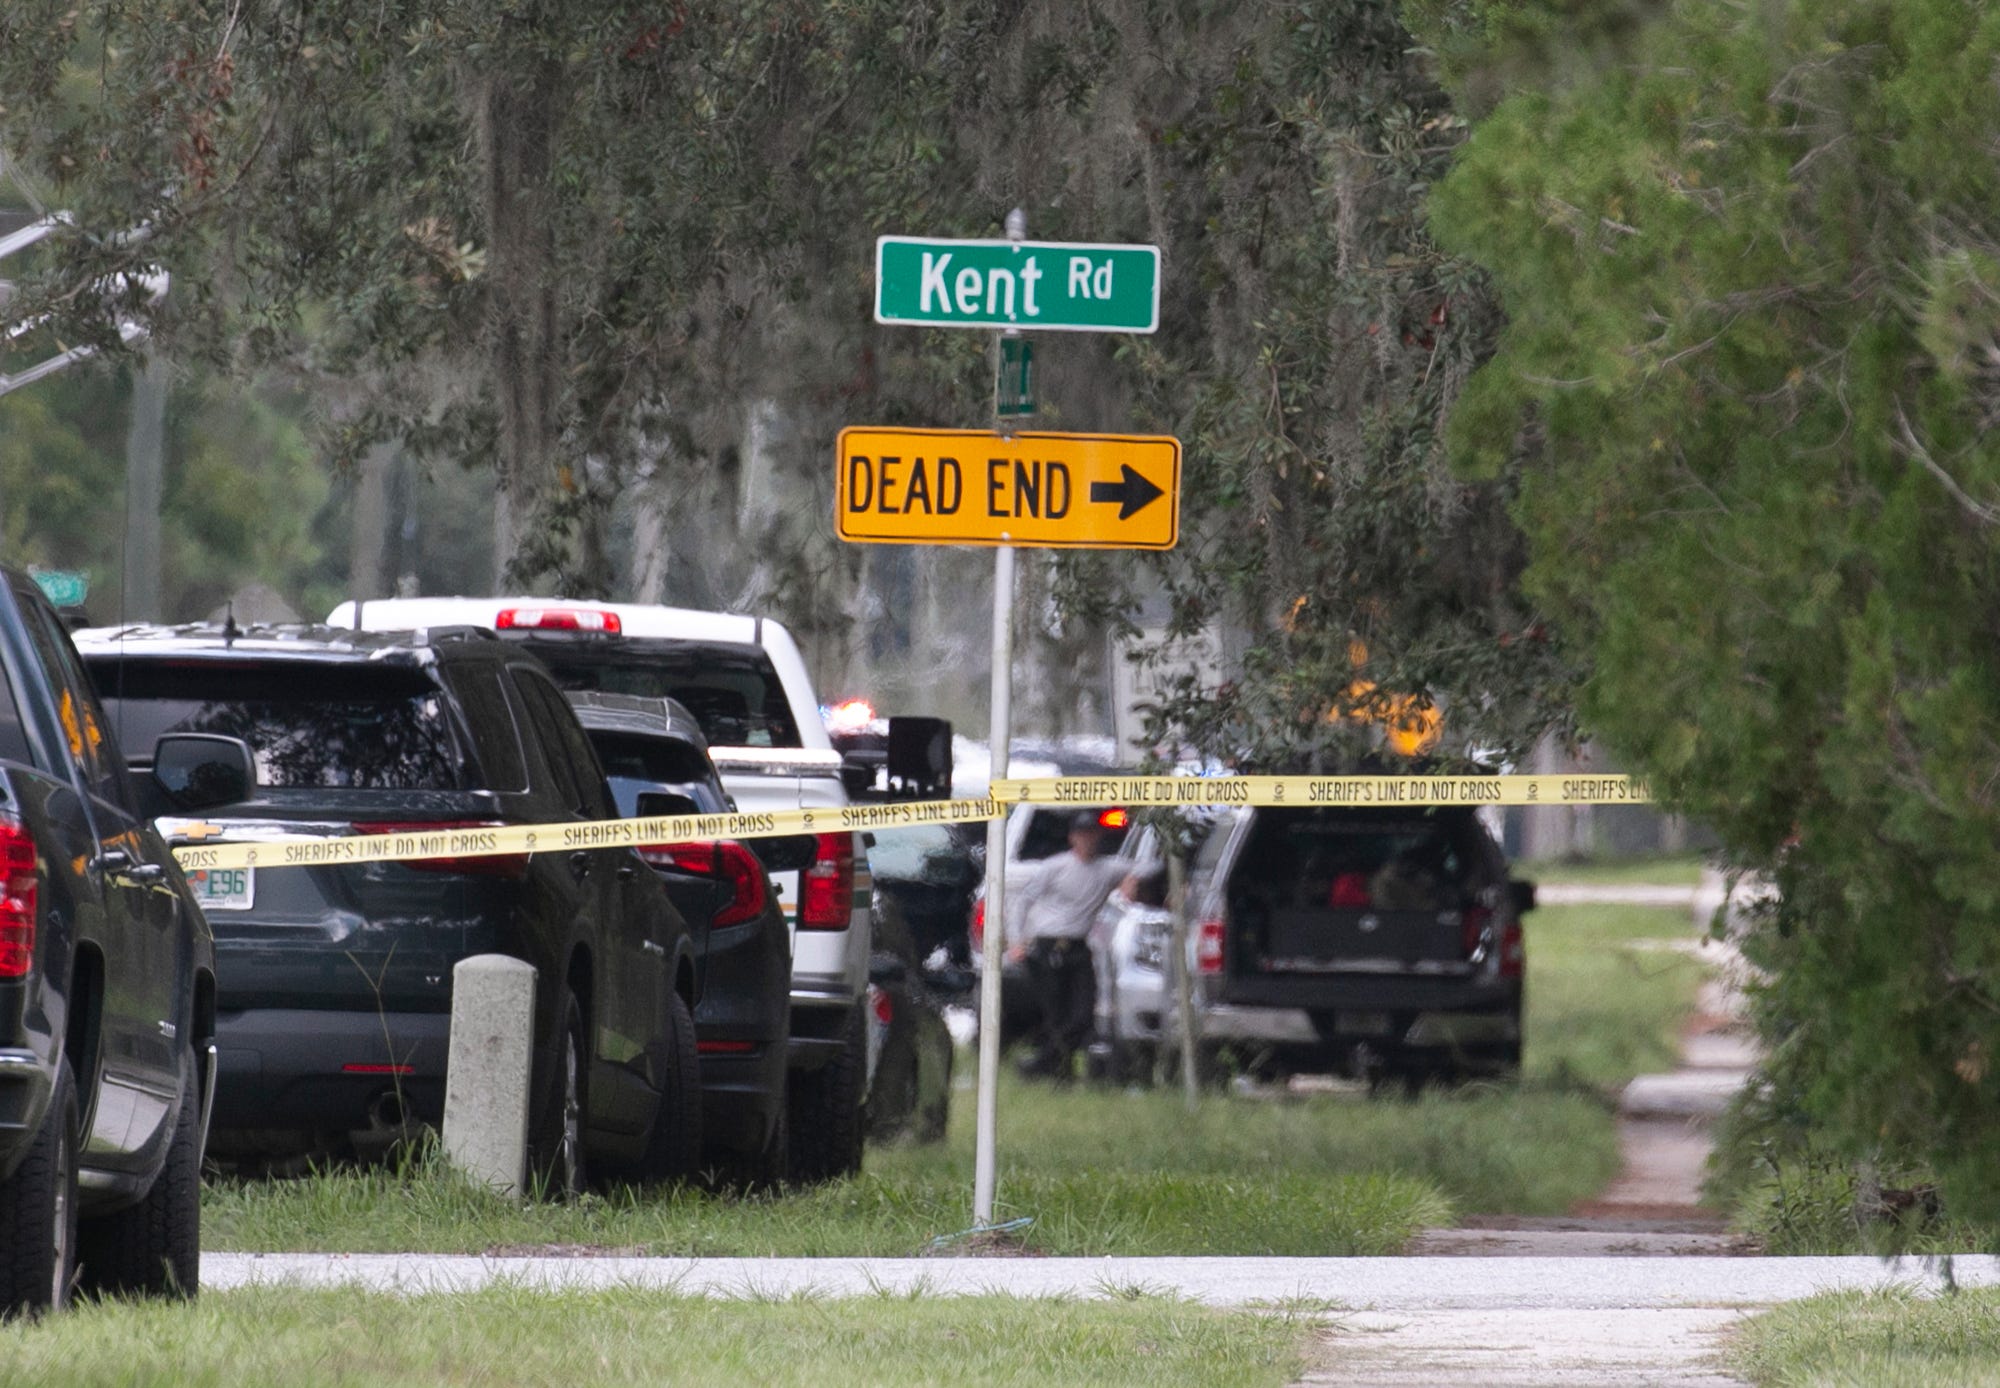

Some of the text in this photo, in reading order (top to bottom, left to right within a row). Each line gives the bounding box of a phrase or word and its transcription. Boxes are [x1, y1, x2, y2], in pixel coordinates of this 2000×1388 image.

[919, 252, 1114, 317] Kent Rd
[848, 455, 1071, 520] DEAD END
[1054, 781, 1249, 801] SHERIFF'S LINE DO NOT CROSS
[1309, 781, 1502, 801] SHERIFF'S LINE DO NOT CROSS
[1562, 779, 1650, 800] SHERIFF'S LIN
[841, 804, 912, 827] SHERIFF'S
[916, 803, 947, 821] LINE
[951, 800, 970, 818] DO
[564, 812, 775, 846] SHERIFF'S LINE DO NOT CROSS
[176, 850, 218, 868] ROSS
[285, 832, 498, 862] SHERIFF'S LINE DO NOT CROSS
